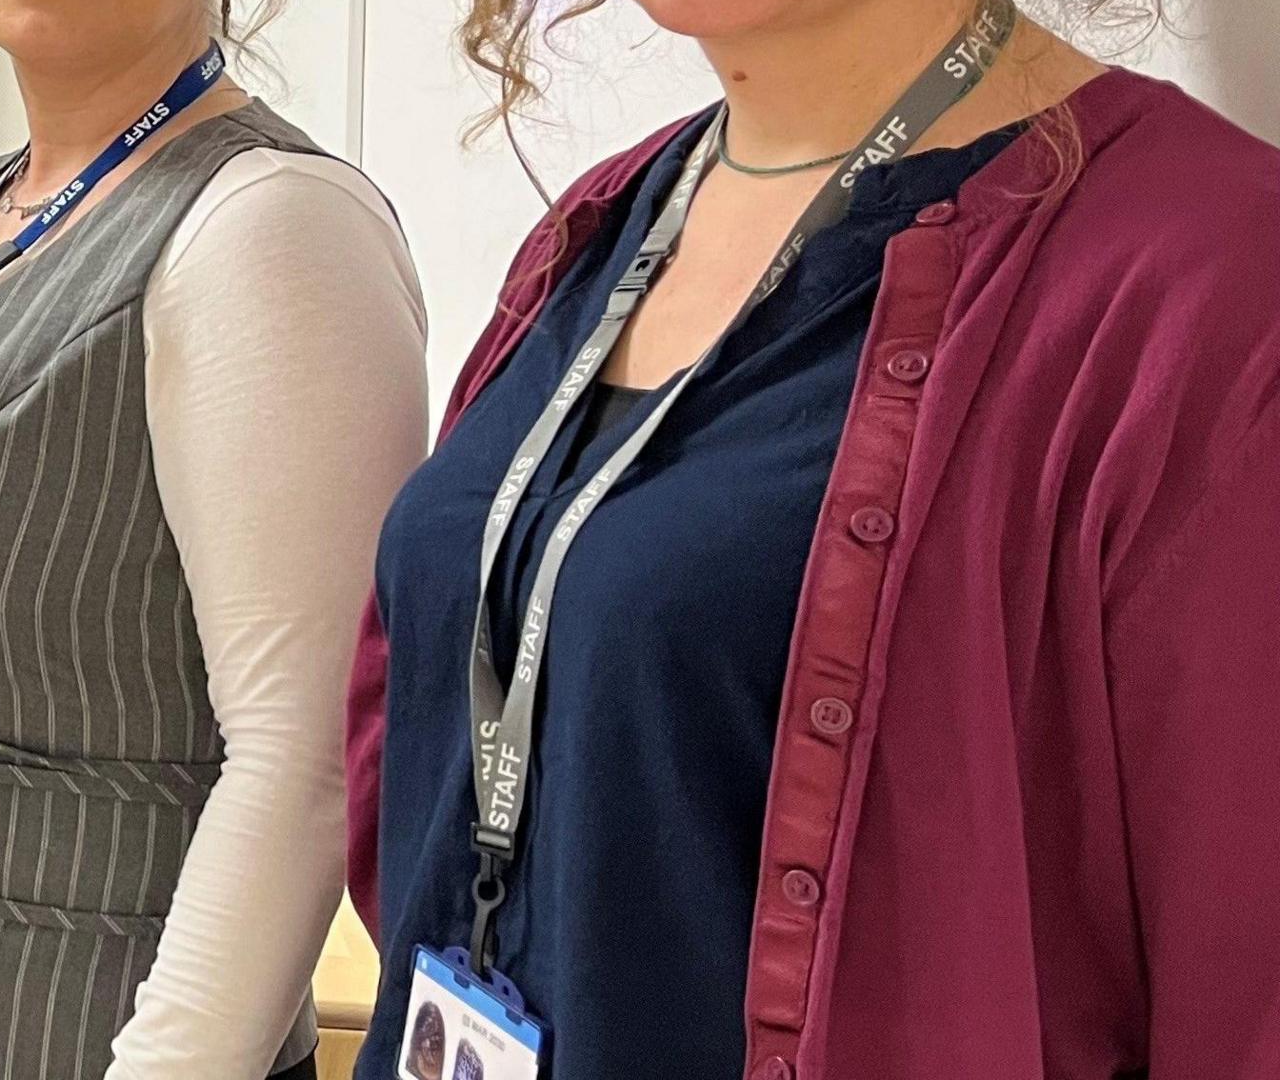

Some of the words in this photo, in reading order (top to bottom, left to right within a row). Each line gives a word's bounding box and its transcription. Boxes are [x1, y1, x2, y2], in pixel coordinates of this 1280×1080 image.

[942, 9, 999, 79] STAFF
[124, 102, 171, 147] STAFF
[40, 179, 86, 225] STAFF
[554, 347, 601, 412] STAFF
[493, 456, 535, 528] STAFF
[556, 467, 611, 542] STAFF
[518, 596, 545, 683] STAFF
[488, 742, 522, 831] STAFF
